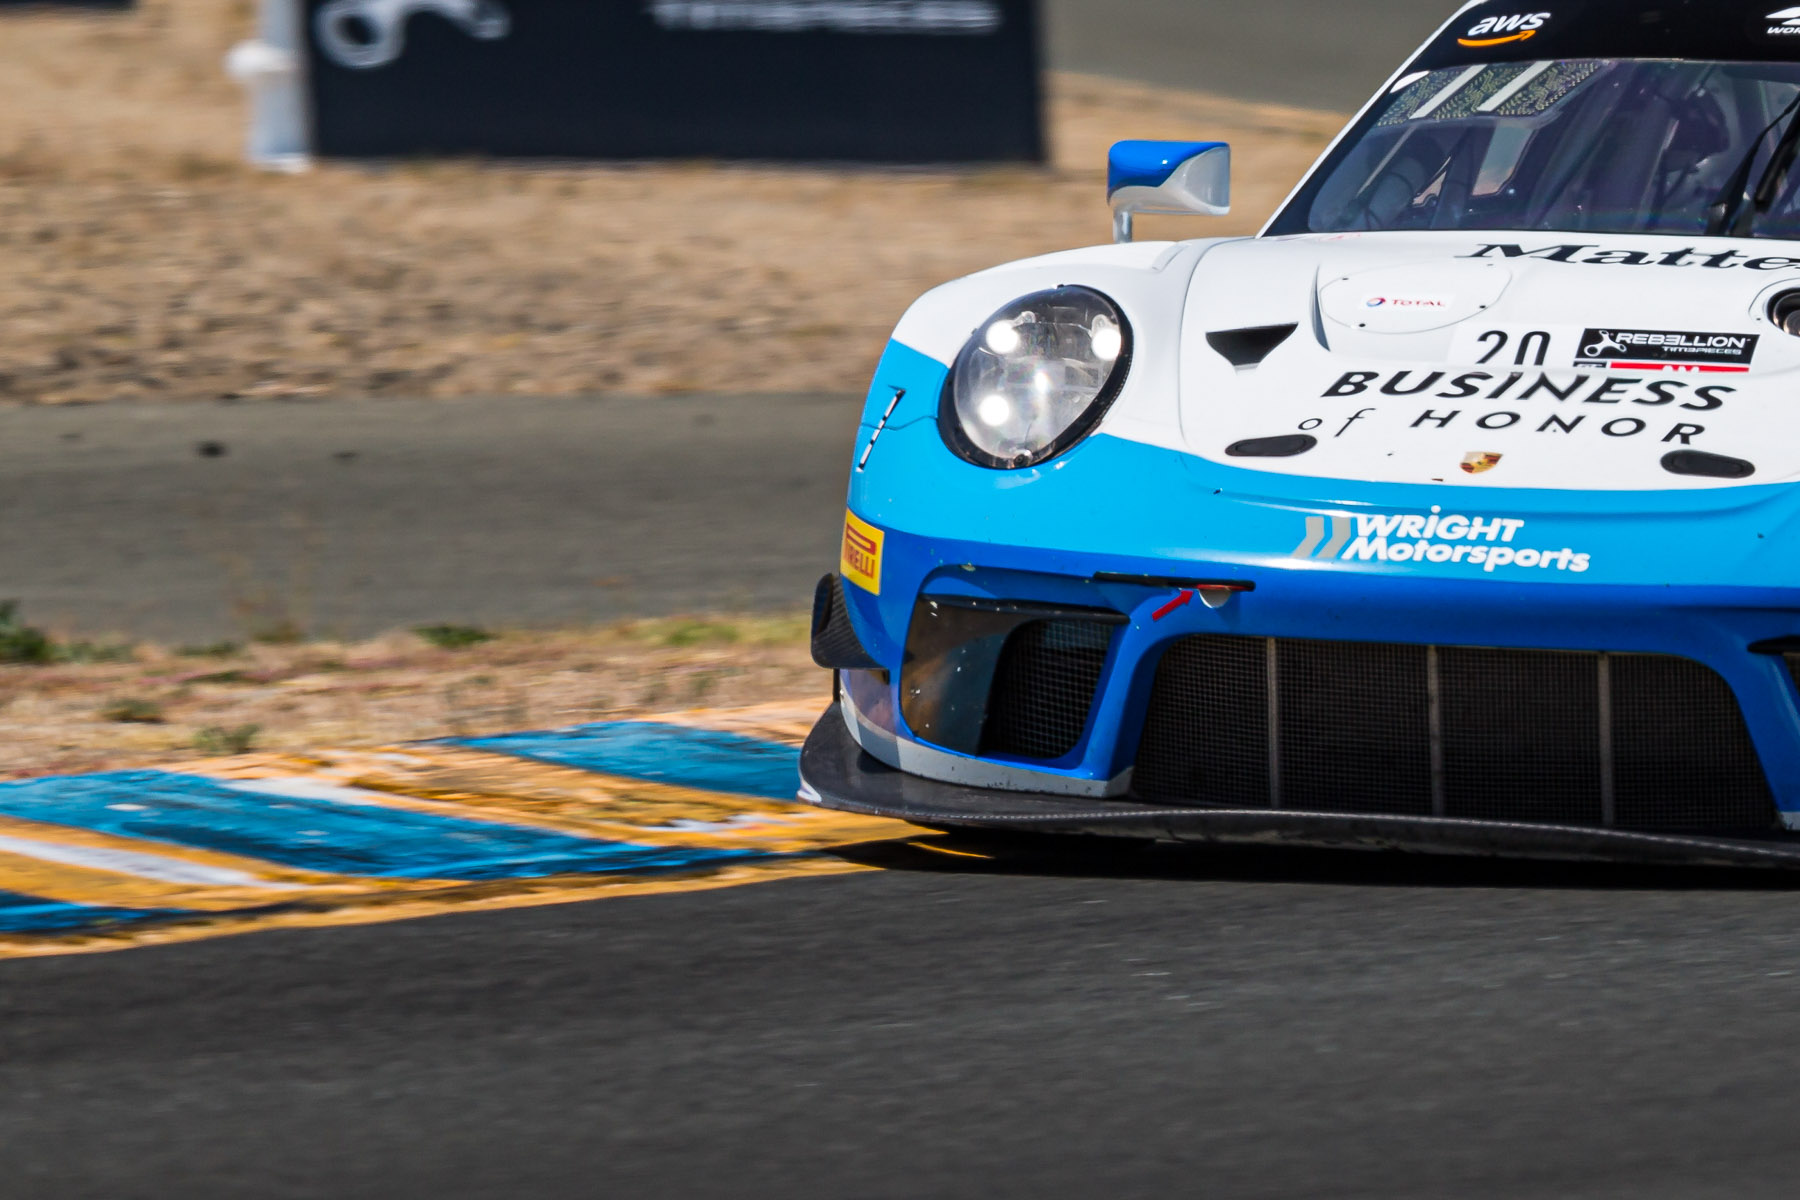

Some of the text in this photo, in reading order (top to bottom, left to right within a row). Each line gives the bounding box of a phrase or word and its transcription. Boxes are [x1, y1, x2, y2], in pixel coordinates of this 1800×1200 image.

[1467, 12, 1551, 36] aws
[1392, 299, 1446, 307] TOTAL
[1321, 370, 1738, 411] BUSINESS
[1297, 407, 1706, 446] of HONOR
[1341, 537, 1591, 573] Motorsports
